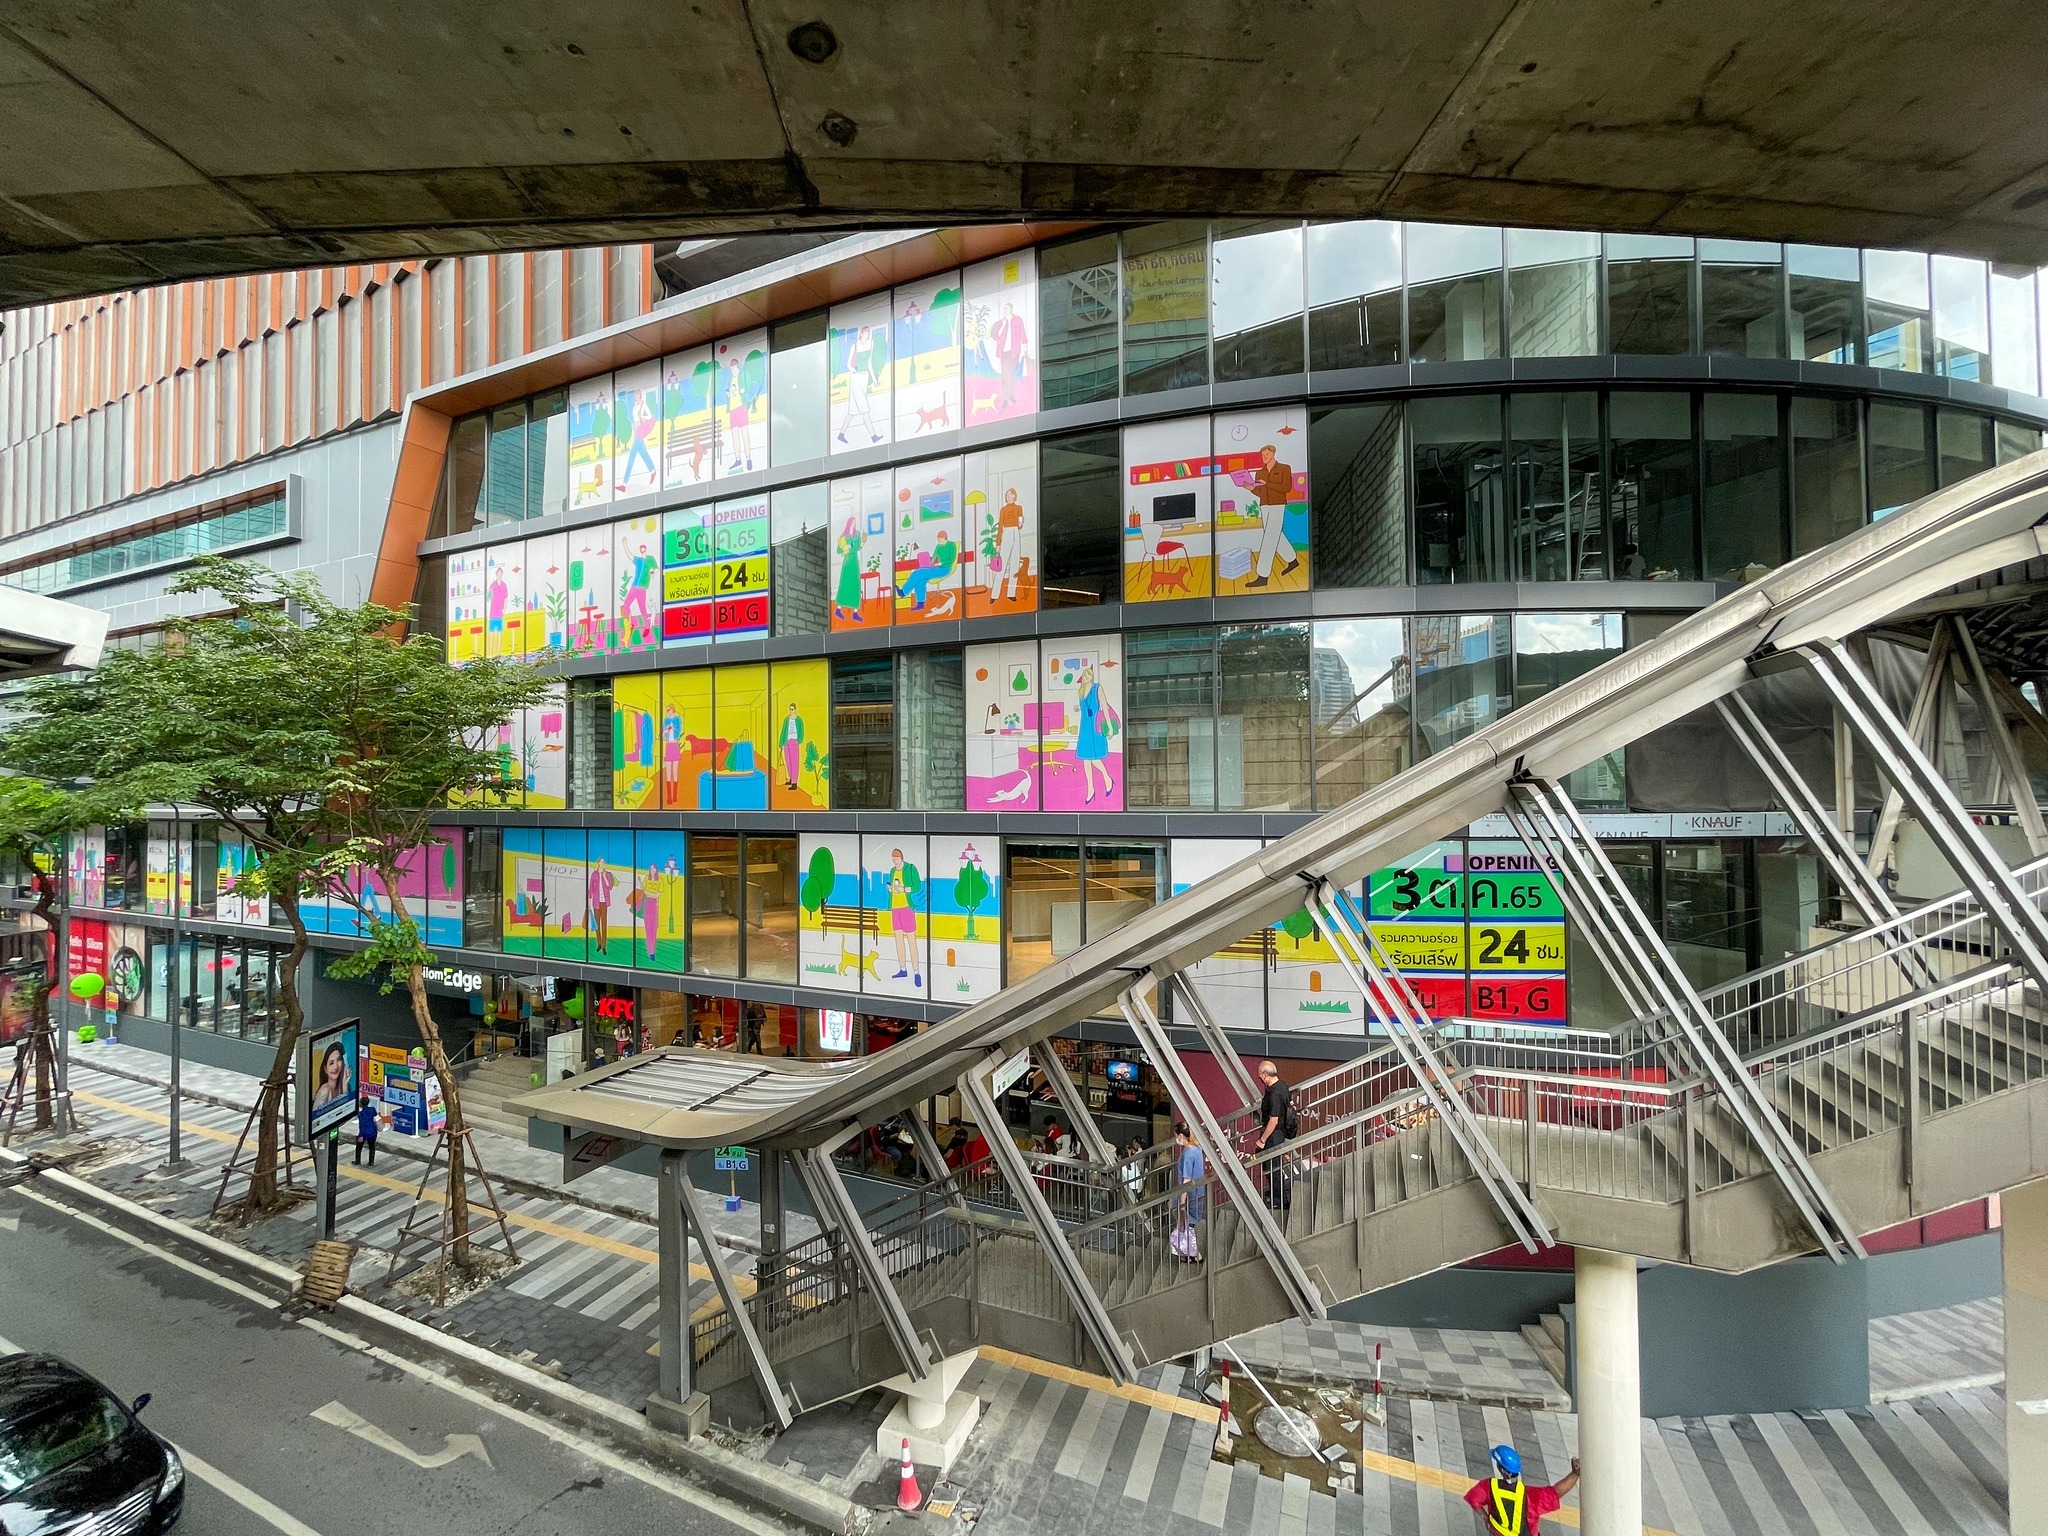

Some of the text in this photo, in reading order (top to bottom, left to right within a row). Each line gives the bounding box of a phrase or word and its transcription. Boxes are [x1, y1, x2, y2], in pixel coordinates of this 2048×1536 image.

[715, 504, 766, 523] OPENING
[675, 528, 691, 560] 3
[669, 571, 710, 583] รวมความอร่อย
[720, 562, 748, 590] 24
[669, 583, 710, 599] พร้อมเสิร์ฟ
[682, 607, 698, 628] ชั้น
[746, 603, 759, 622] G
[1691, 816, 1743, 828] KNAUF
[1469, 856, 1560, 870] OPENING
[1392, 868, 1422, 911] 3
[1380, 932, 1459, 944] รวมความอร่อย
[1478, 928, 1564, 964] 24 ชม.
[1382, 949, 1459, 967] ร้อมเสิร์ฟ
[597, 996, 634, 1020] KFC
[1477, 985, 1550, 1014] B1, G
[373, 1063, 379, 1076] 3
[716, 1145, 730, 1156] 24
